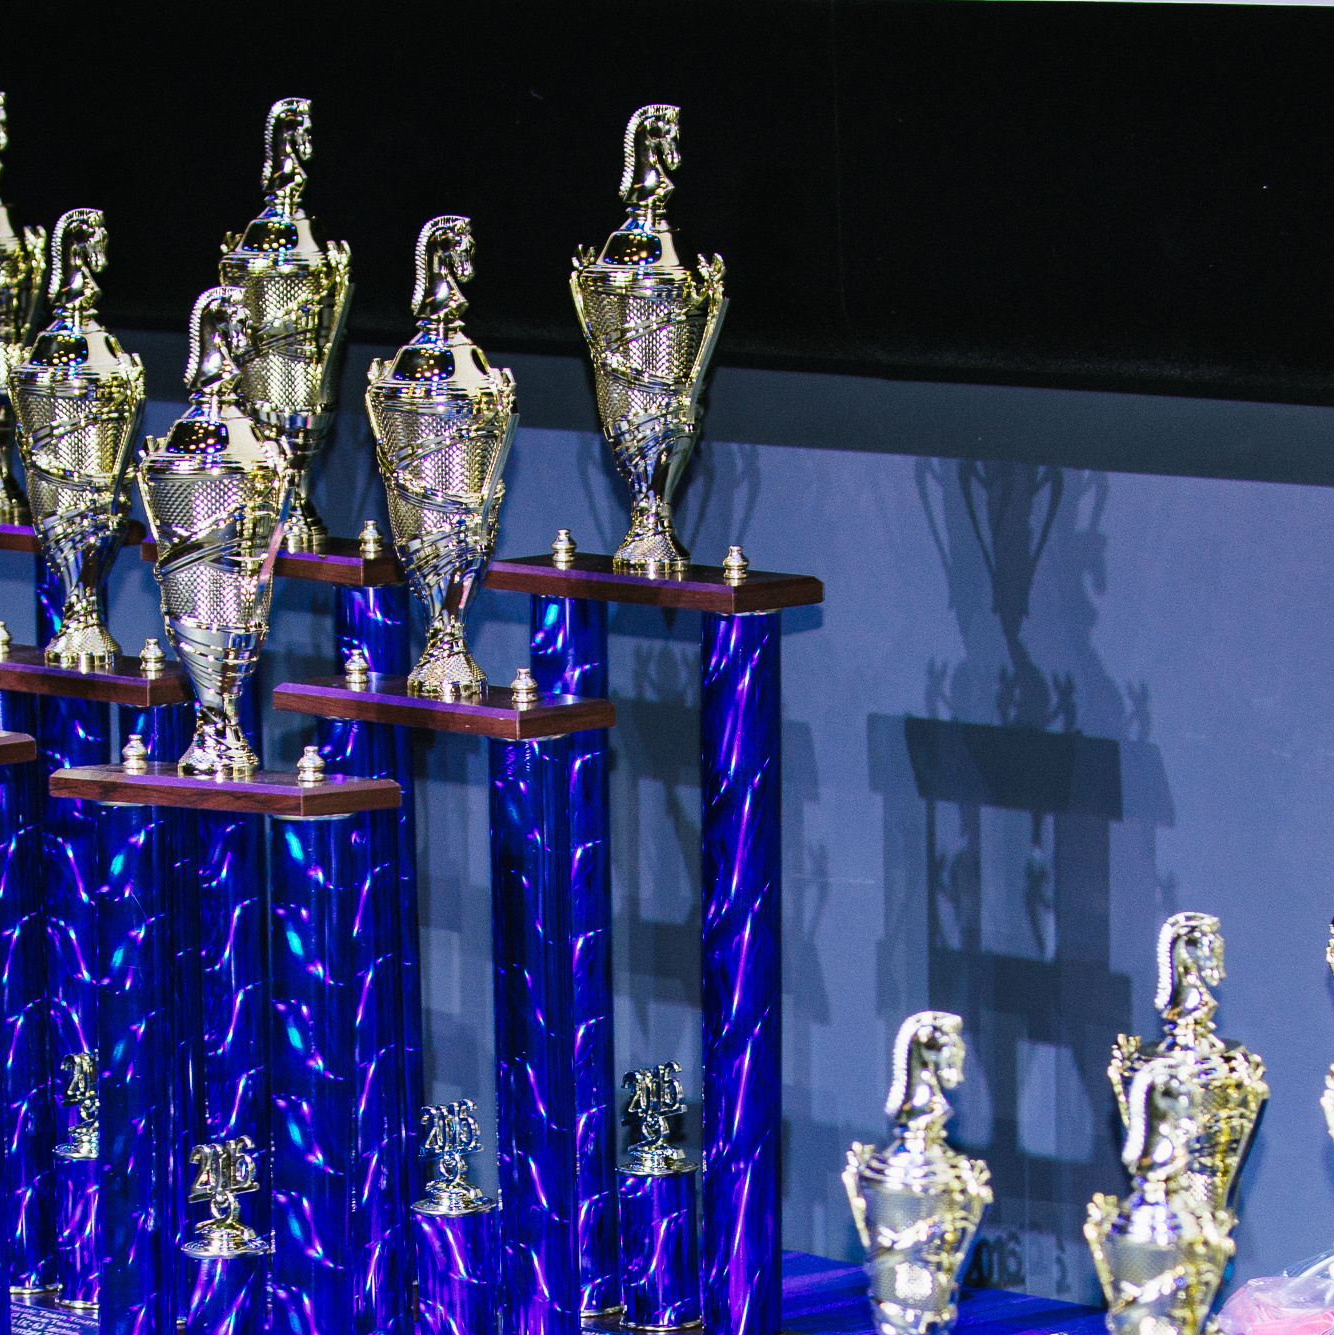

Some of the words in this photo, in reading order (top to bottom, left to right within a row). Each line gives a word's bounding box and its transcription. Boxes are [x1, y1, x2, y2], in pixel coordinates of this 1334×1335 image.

[190, 1135, 256, 1194] 2016
[20, 1313, 49, 1322] Place
[49, 1319, 81, 1328] Team
